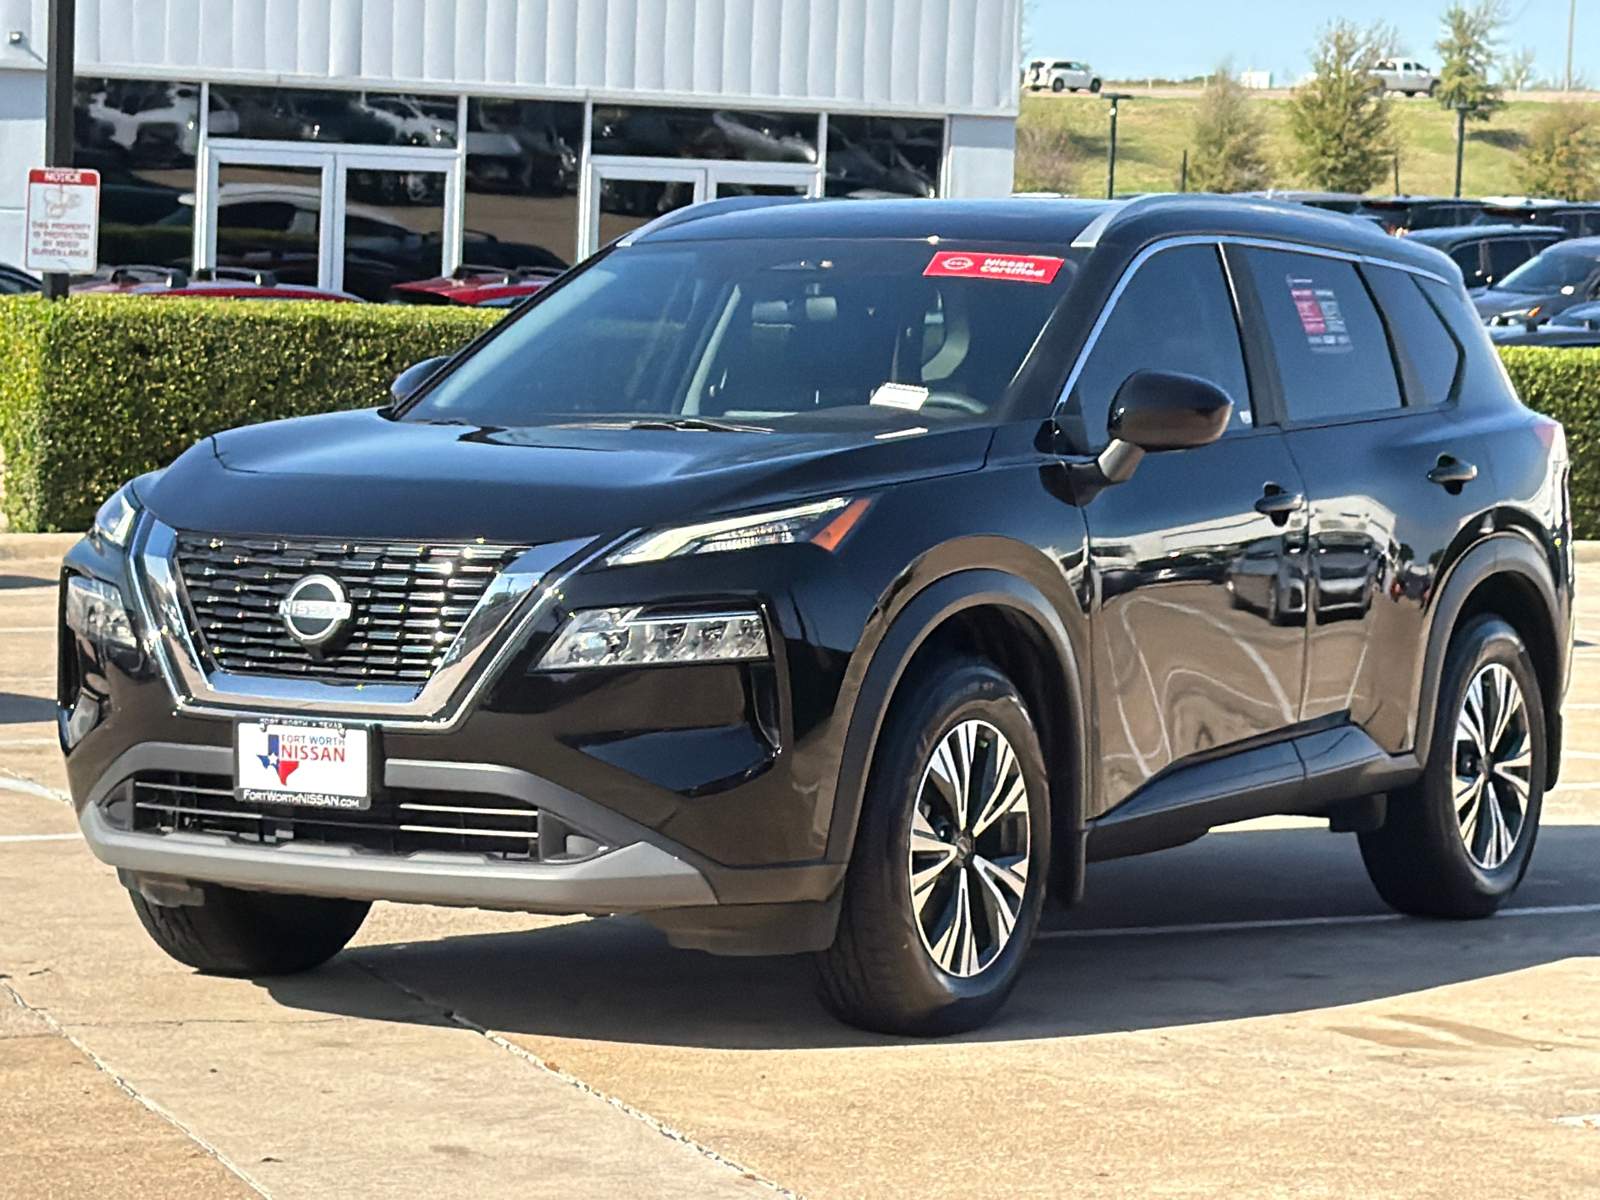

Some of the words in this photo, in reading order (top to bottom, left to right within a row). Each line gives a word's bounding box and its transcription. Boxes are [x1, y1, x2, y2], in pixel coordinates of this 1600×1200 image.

[44, 171, 81, 183] NOTICE
[984, 258, 1034, 269] Nissan
[980, 265, 1045, 277] Certified
[281, 734, 306, 744] FORT
[309, 735, 346, 746] WORTH
[281, 744, 346, 763] NISSAN
